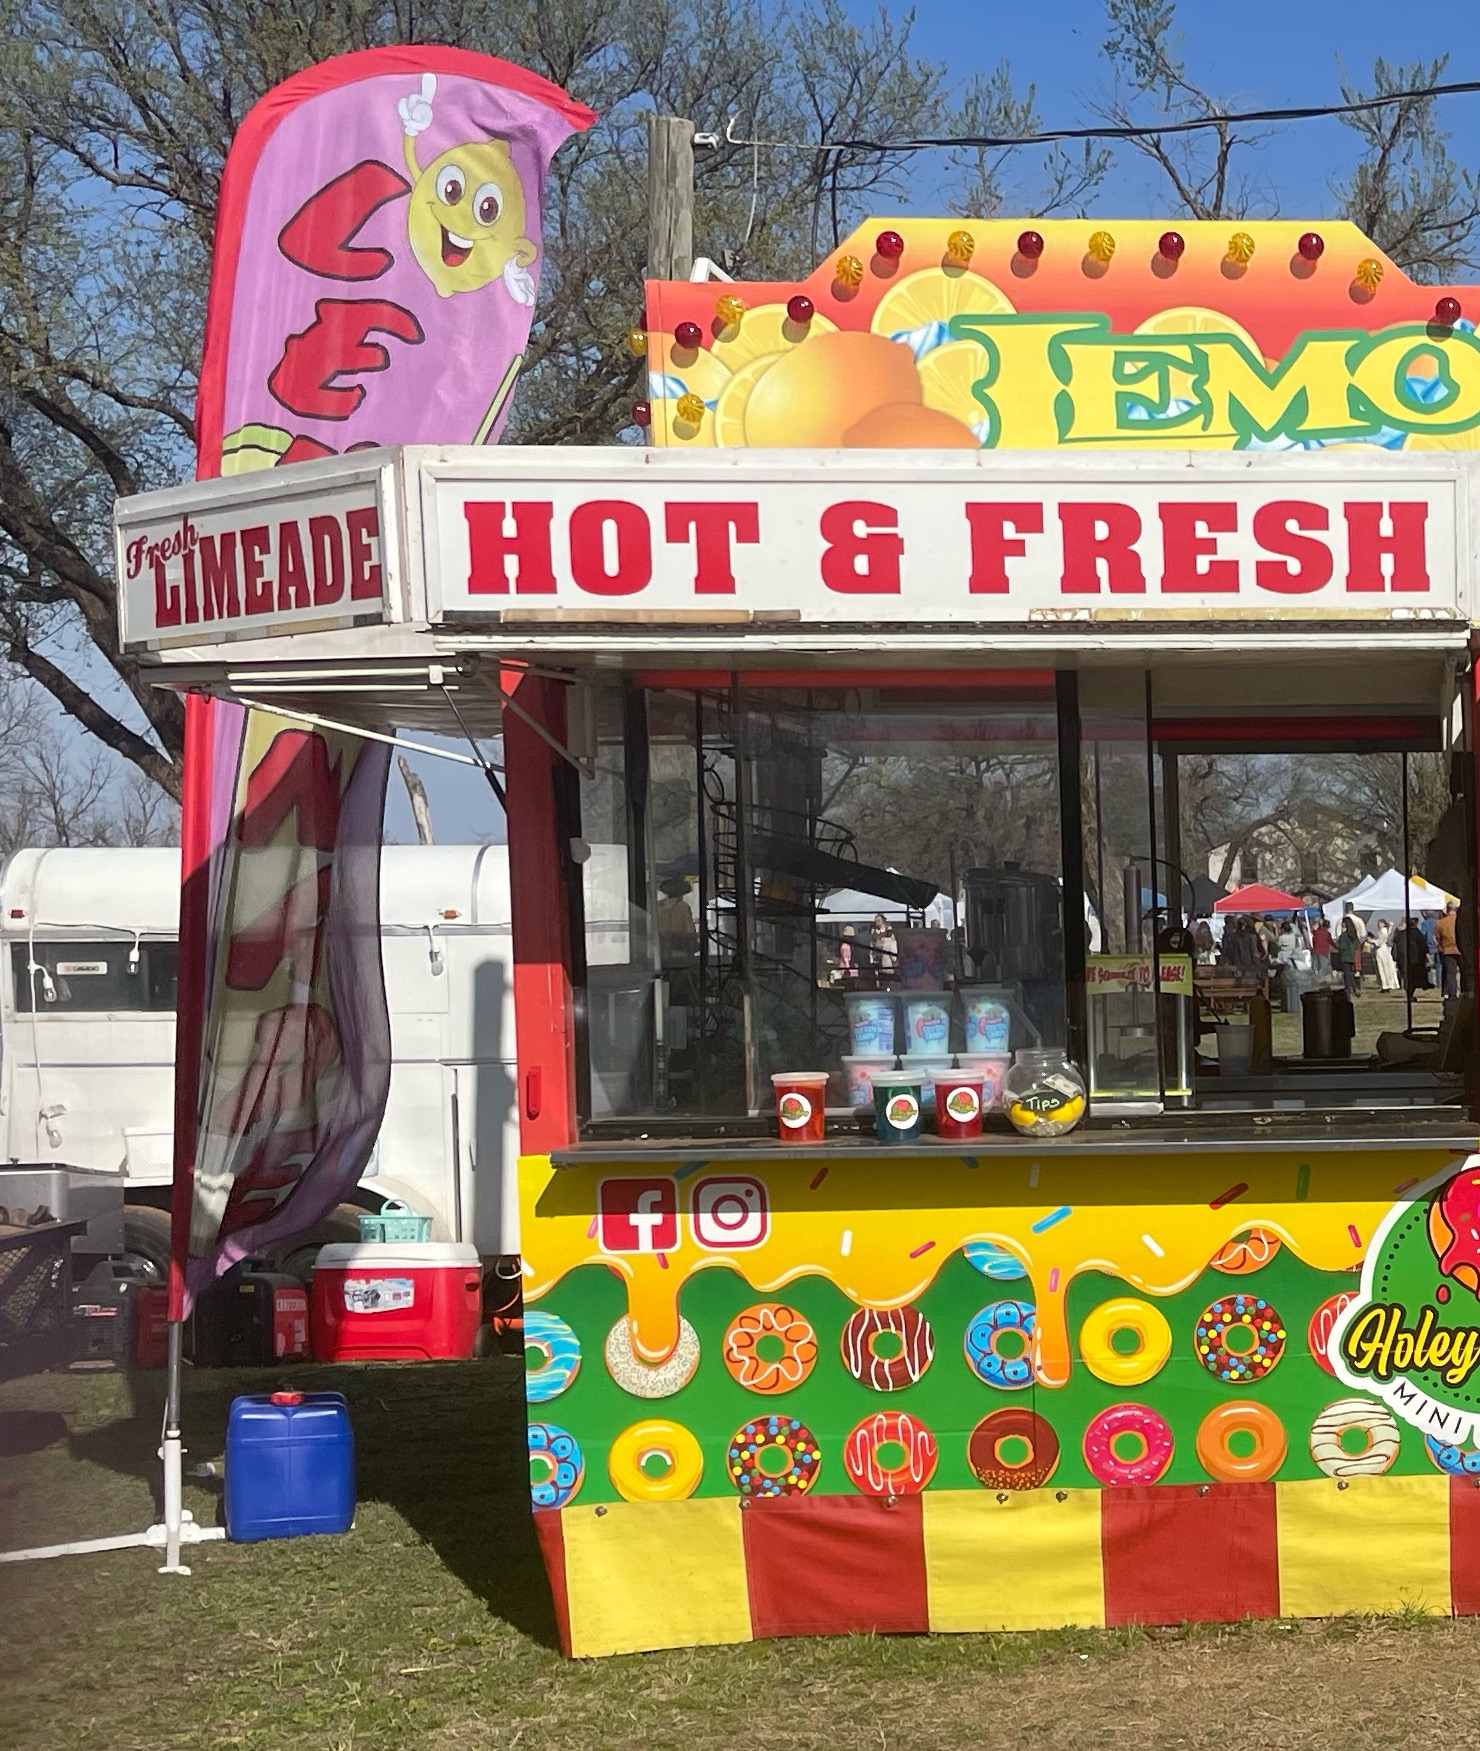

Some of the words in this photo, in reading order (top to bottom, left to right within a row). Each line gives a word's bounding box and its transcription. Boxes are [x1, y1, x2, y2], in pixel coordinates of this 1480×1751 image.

[126, 513, 198, 580] Fresh
[154, 506, 383, 629] LIMEADE
[462, 499, 761, 597] HOT
[819, 499, 906, 597] &
[964, 499, 1432, 596] FRESH
[1393, 1381, 1463, 1435] MINI
